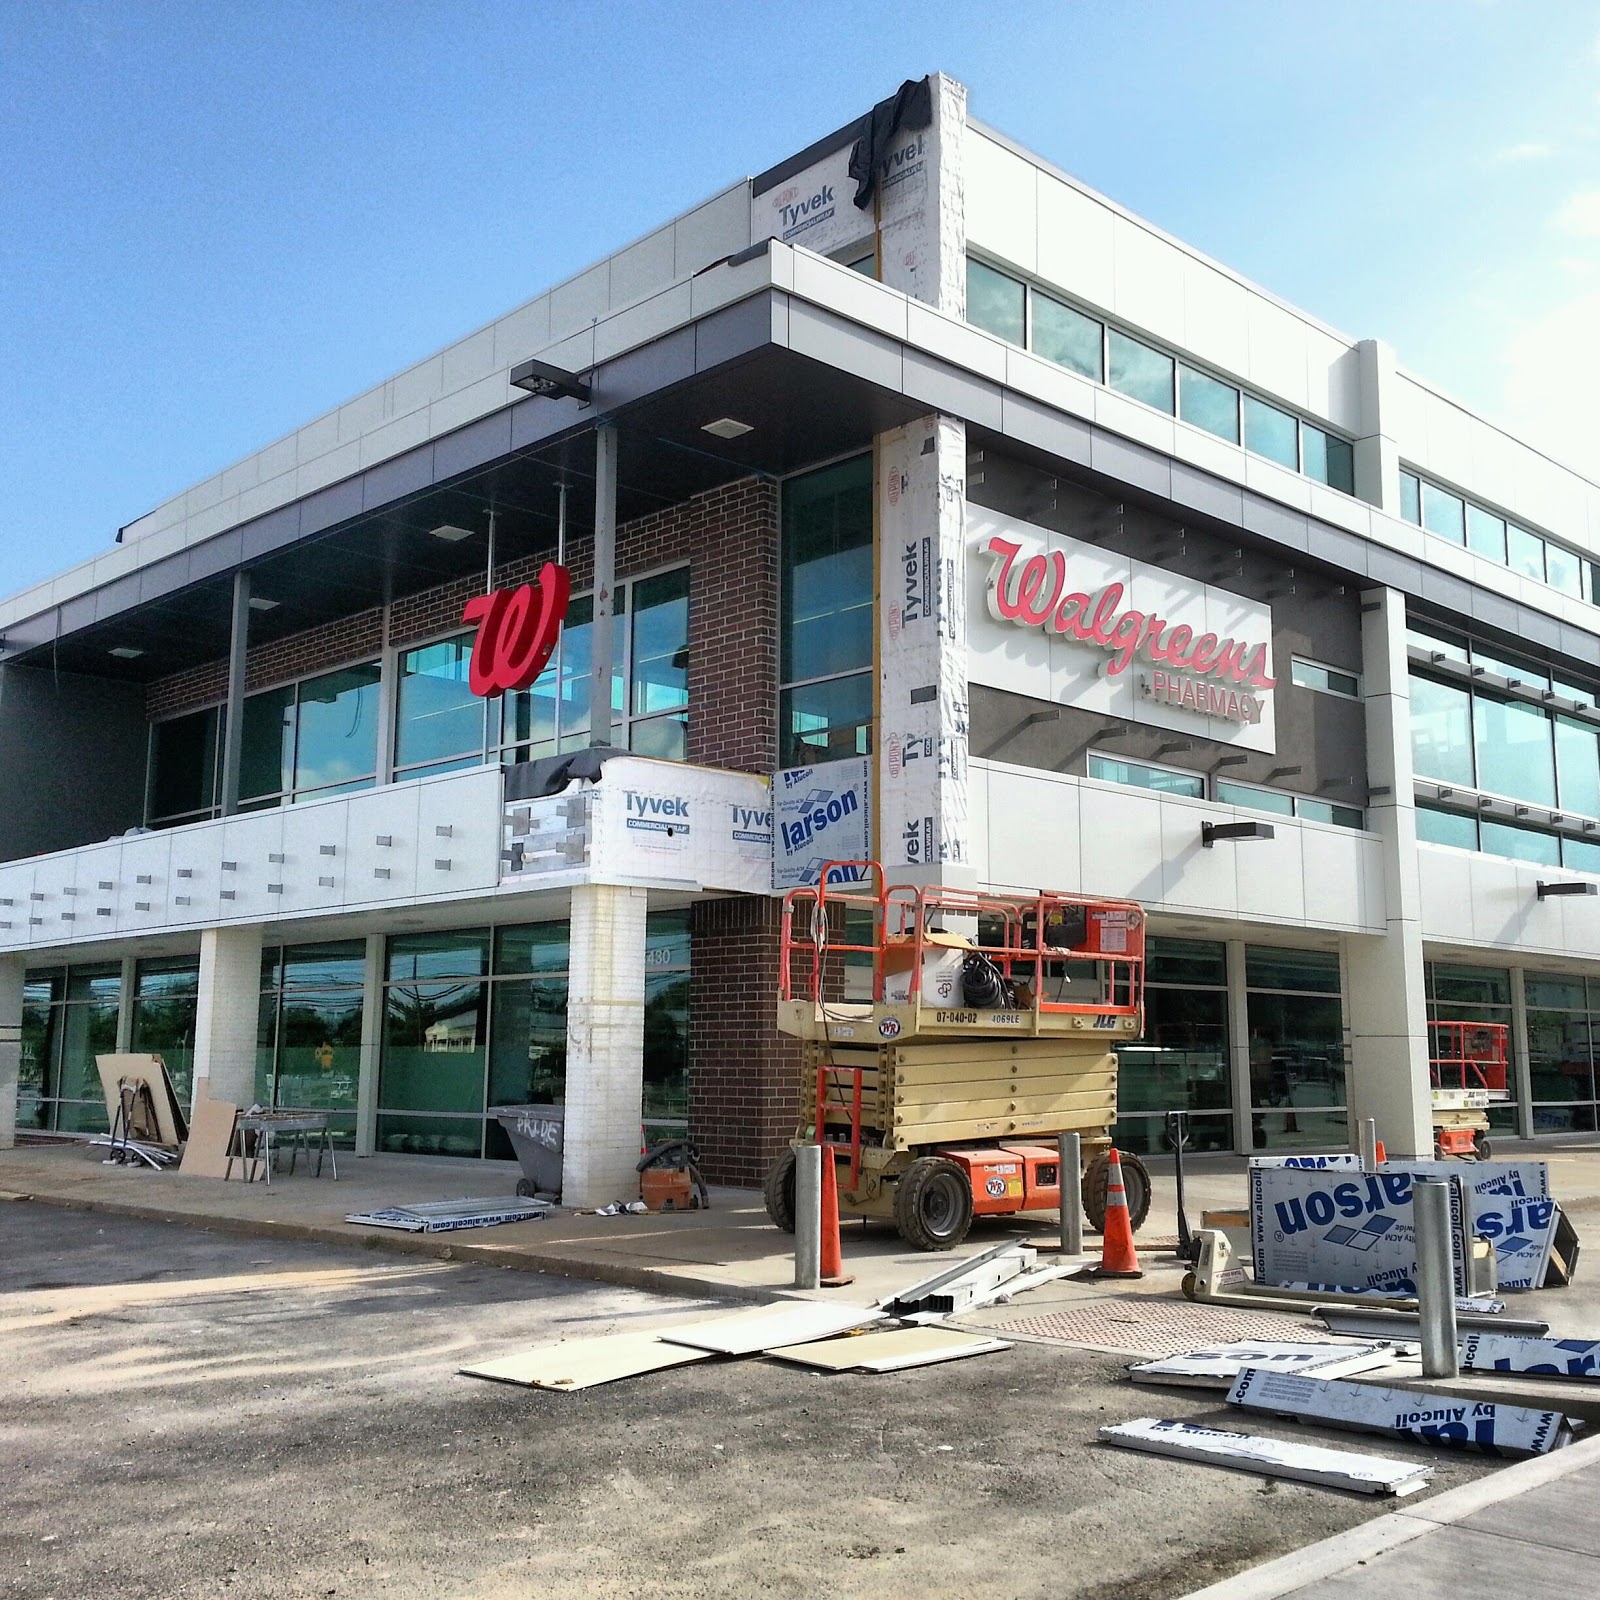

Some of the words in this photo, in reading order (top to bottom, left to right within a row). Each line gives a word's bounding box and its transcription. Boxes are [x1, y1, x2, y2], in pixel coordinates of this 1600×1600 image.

[779, 184, 834, 227] Tyvek
[902, 541, 922, 628] Tyvek
[979, 536, 1278, 689] Walgreens
[462, 562, 572, 699] W
[1152, 671, 1266, 723] PHARMACY
[622, 790, 689, 817] Tyvek
[627, 818, 690, 834] COMMERCIALRAP
[780, 788, 858, 850] larson
[1092, 1014, 1118, 1029] JLG
[517, 1117, 562, 1145] PRIDE
[1475, 1174, 1507, 1195] Alucoil
[1508, 1170, 1521, 1181] by
[1274, 1172, 1414, 1236] arson
[433, 1215, 502, 1229] www.alucoil.com
[1384, 1234, 1400, 1242] ACM
[1366, 1266, 1408, 1287] Alucoil
[1395, 1407, 1466, 1429] Alucoil
[1472, 1402, 1496, 1418] by
